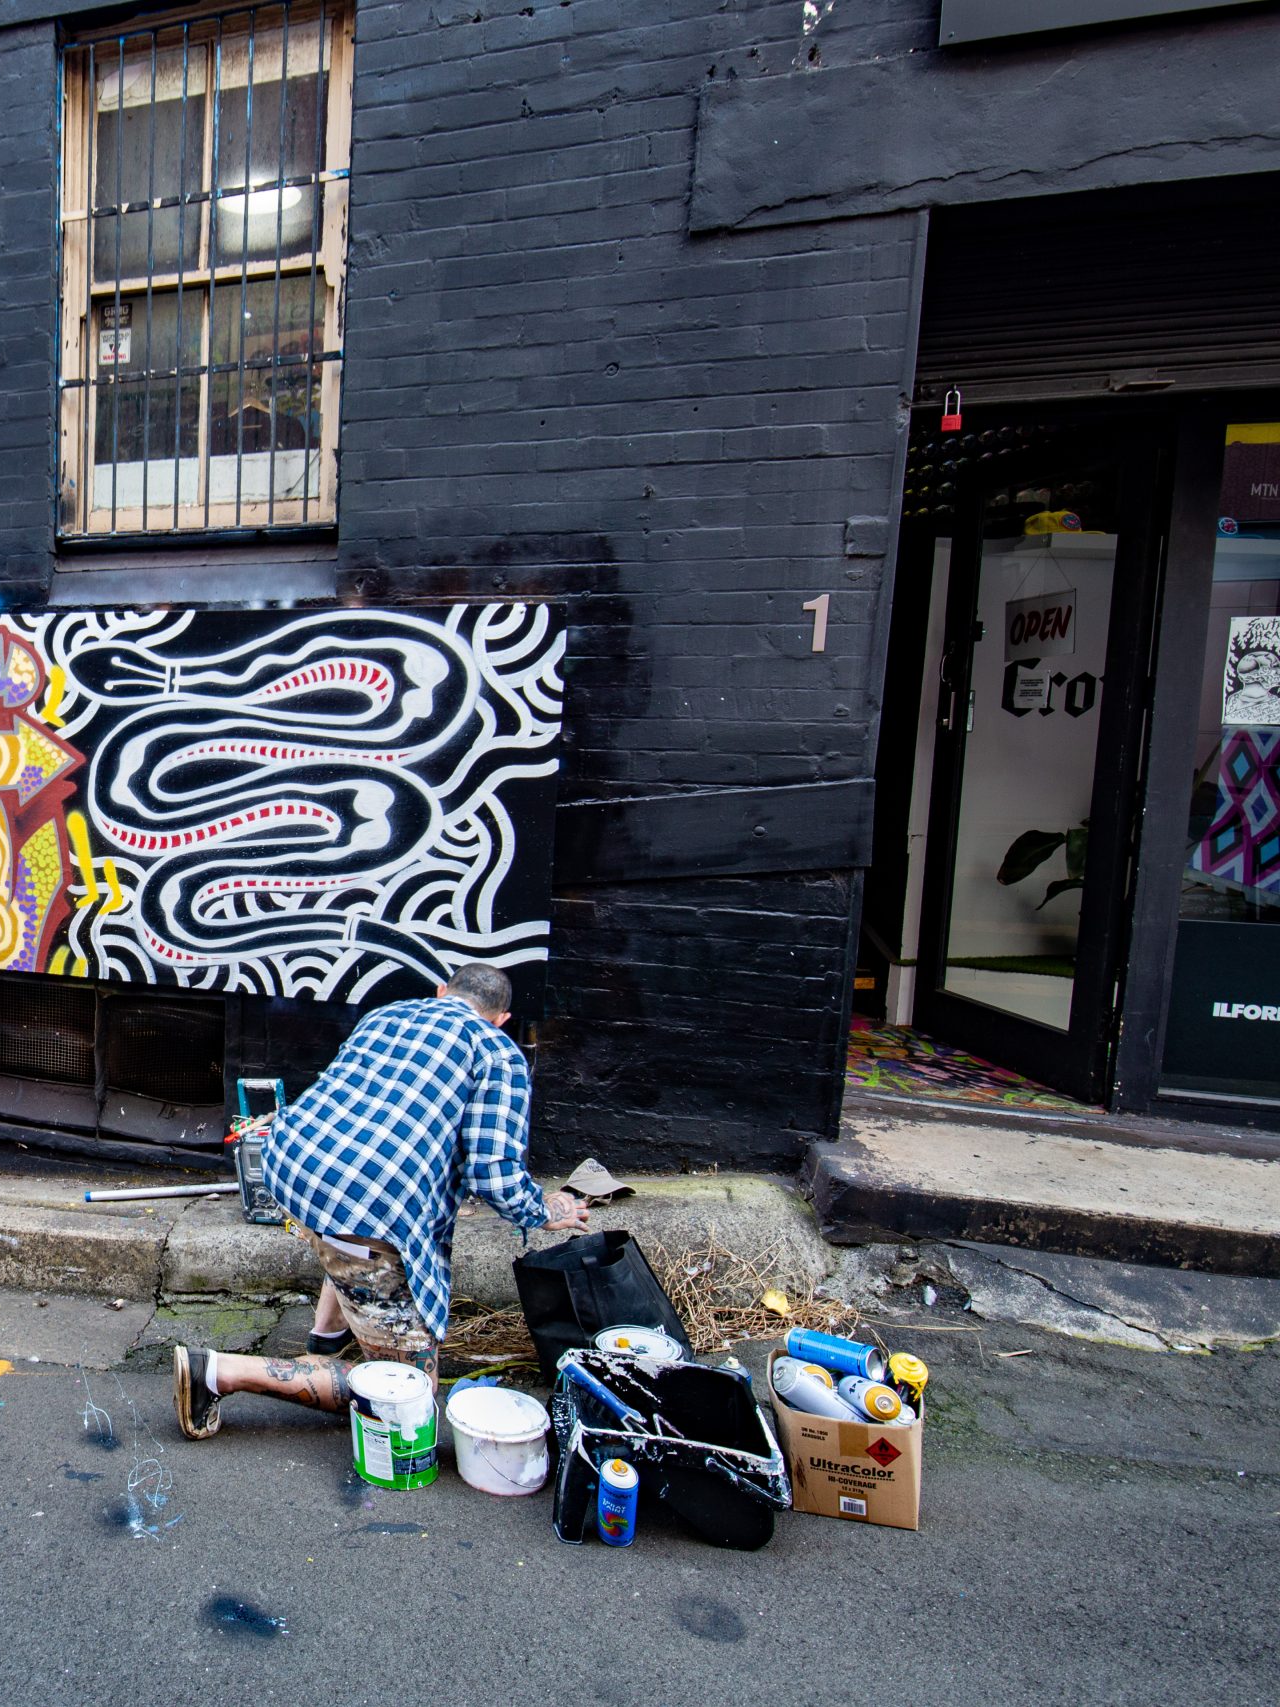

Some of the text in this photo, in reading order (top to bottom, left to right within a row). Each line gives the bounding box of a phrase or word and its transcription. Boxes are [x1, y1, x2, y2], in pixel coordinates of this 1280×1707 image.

[1250, 483, 1279, 497] MTN
[802, 593, 830, 652] 1
[1010, 604, 1073, 646] OPEN
[1001, 657, 1105, 718] Cro
[1212, 1001, 1280, 1022] ILFOR
[809, 1456, 895, 1479] UltraColor
[827, 1475, 877, 1490] HI-COVERAGE
